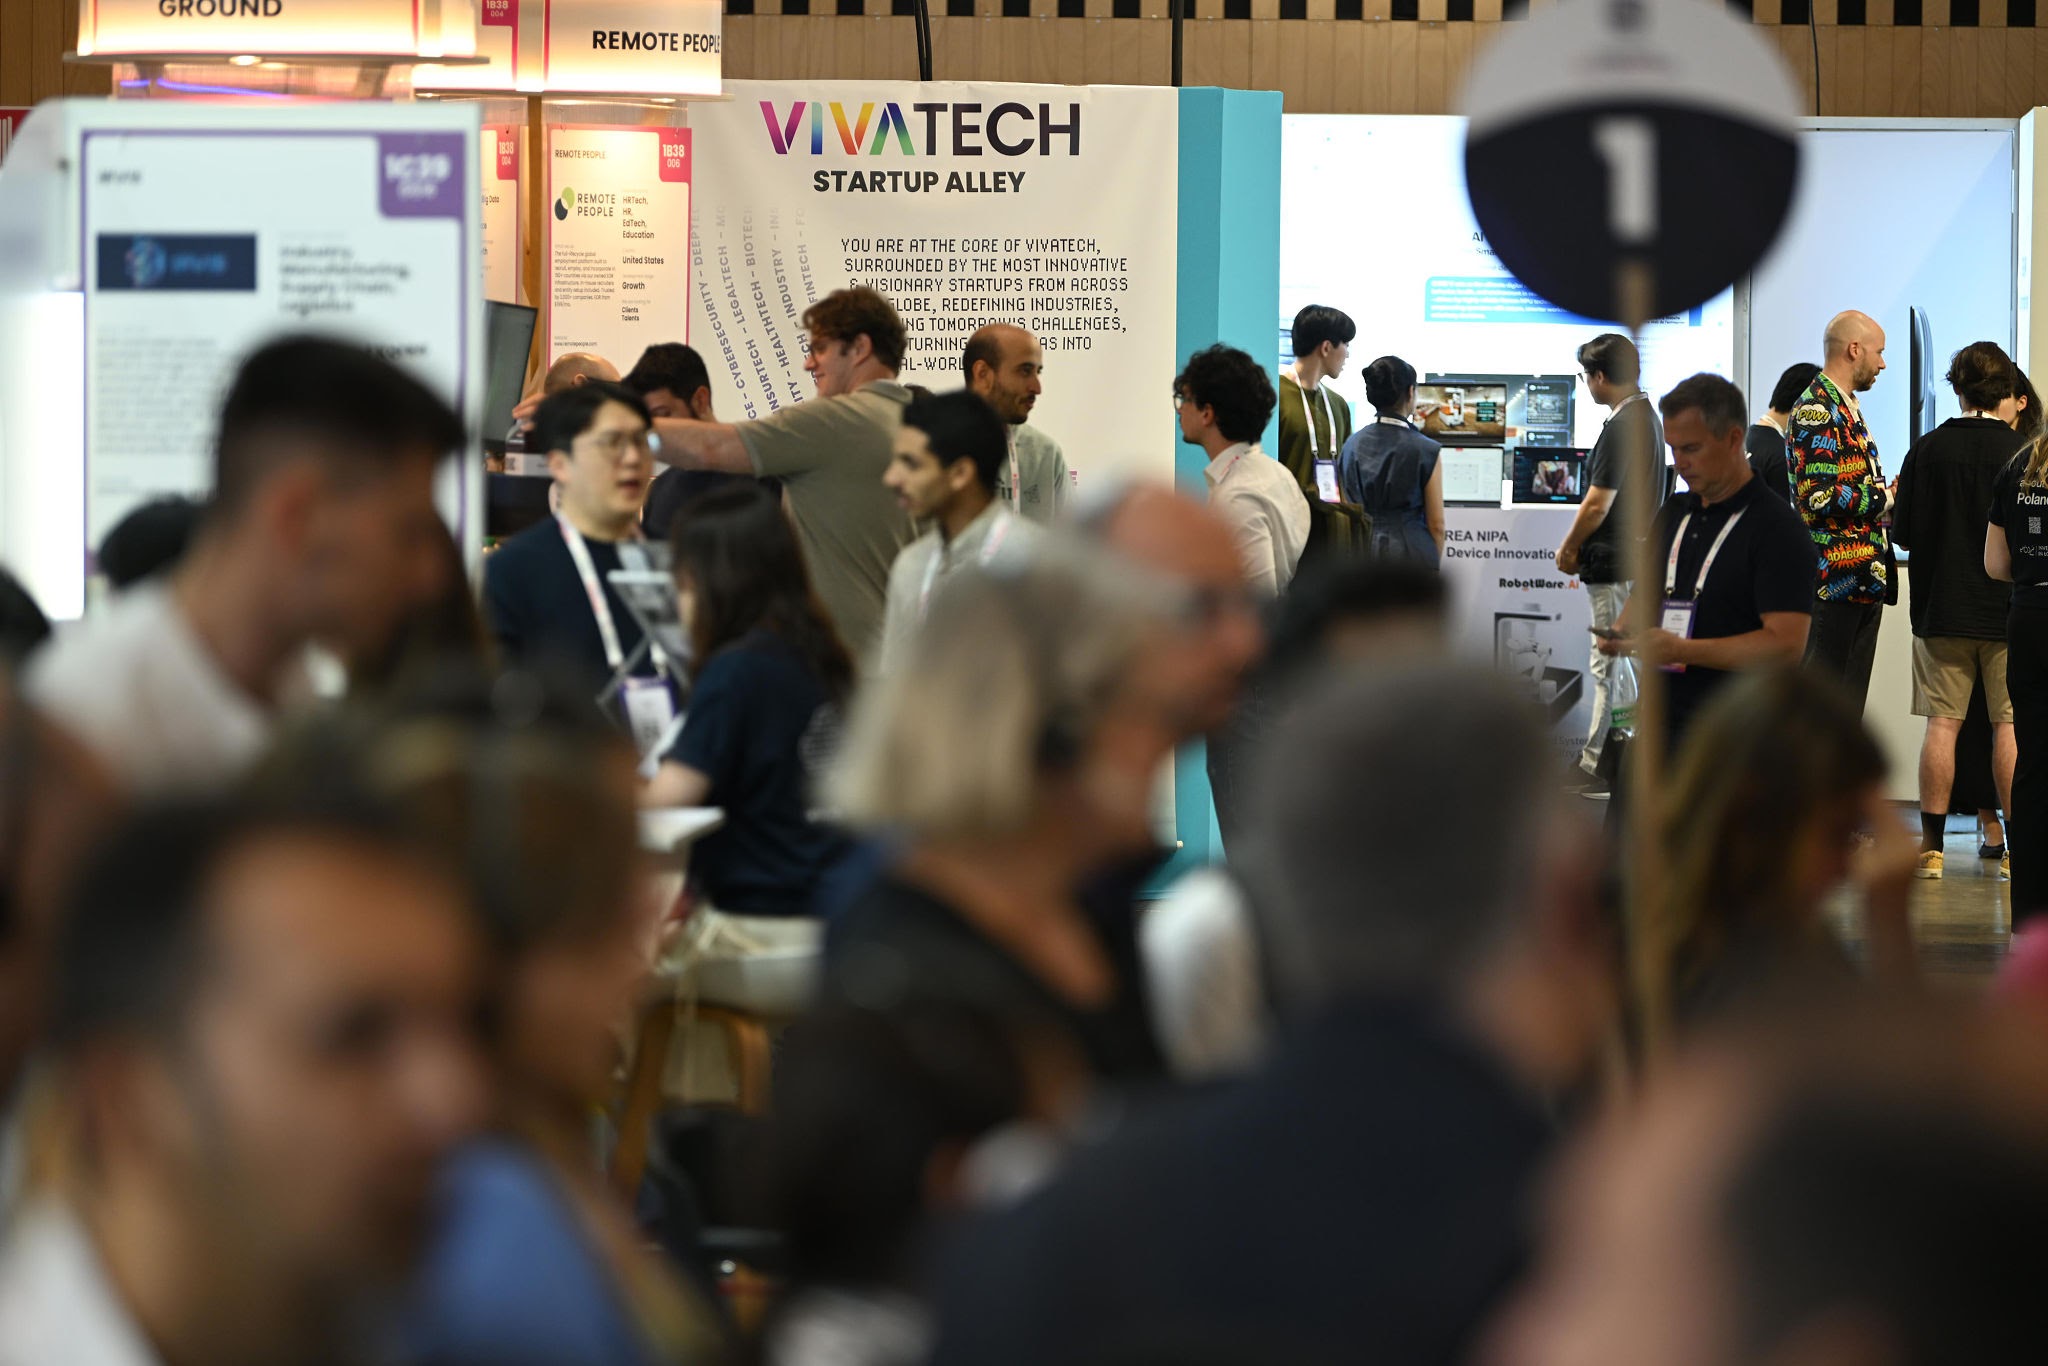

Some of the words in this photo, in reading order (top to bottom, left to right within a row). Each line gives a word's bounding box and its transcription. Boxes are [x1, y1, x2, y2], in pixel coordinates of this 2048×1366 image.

[158, 0, 282, 17] GROUND
[592, 30, 679, 51] REMOTE
[683, 33, 720, 53] PEOPLE
[759, 101, 1080, 157] VIVATECH
[555, 149, 581, 159] REMOTE
[582, 150, 606, 159] PEOPLE
[662, 144, 685, 158] 1B38
[667, 159, 680, 168] 006
[813, 169, 939, 193] STARTUP
[944, 171, 1027, 193] ALLEY
[577, 193, 616, 205] REMOTE
[577, 206, 614, 217] PEOPLE
[622, 230, 655, 239] Education
[841, 238, 870, 253] YOU
[876, 238, 904, 253] ARE
[910, 238, 927, 253] AT
[931, 238, 956, 253] THE
[961, 238, 999, 253] CORE
[1004, 238, 1021, 253] OF
[1025, 238, 1101, 255] VIVATECH,
[622, 256, 643, 264] United
[644, 256, 665, 265] States
[844, 258, 943, 273] SURROUNDED
[948, 258, 968, 273] BY
[972, 258, 997, 272] THE
[1003, 258, 1041, 272] MOST
[1045, 258, 1127, 272] INNOVATIVE
[797, 244, 817, 304] FINTECH
[622, 281, 646, 290] Growth
[717, 245, 746, 325] LEGALTECH
[771, 248, 798, 319] INDUSTRY
[866, 278, 943, 292] VISIONARY
[948, 278, 1023, 292] STARTUPS
[1028, 278, 1065, 292] FROM
[1071, 277, 1128, 292] ACROSS
[942, 297, 1025, 312] REDEFINING
[1031, 297, 1118, 314] INDUSTRIES,
[750, 281, 790, 368] HEALTHTECH
[1032, 316, 1126, 333] CHALLENGES,
[698, 281, 746, 389] CYBERSECURITY
[907, 337, 968, 351] TURNING
[1062, 336, 1092, 350] INTO
[746, 339, 781, 414] NSURTECH
[1798, 410, 1830, 424] POW!
[1445, 530, 1473, 541] REA
[1477, 530, 1509, 542] NIPA
[1446, 546, 1491, 559] Device
[1494, 548, 1556, 560] Innovatio
